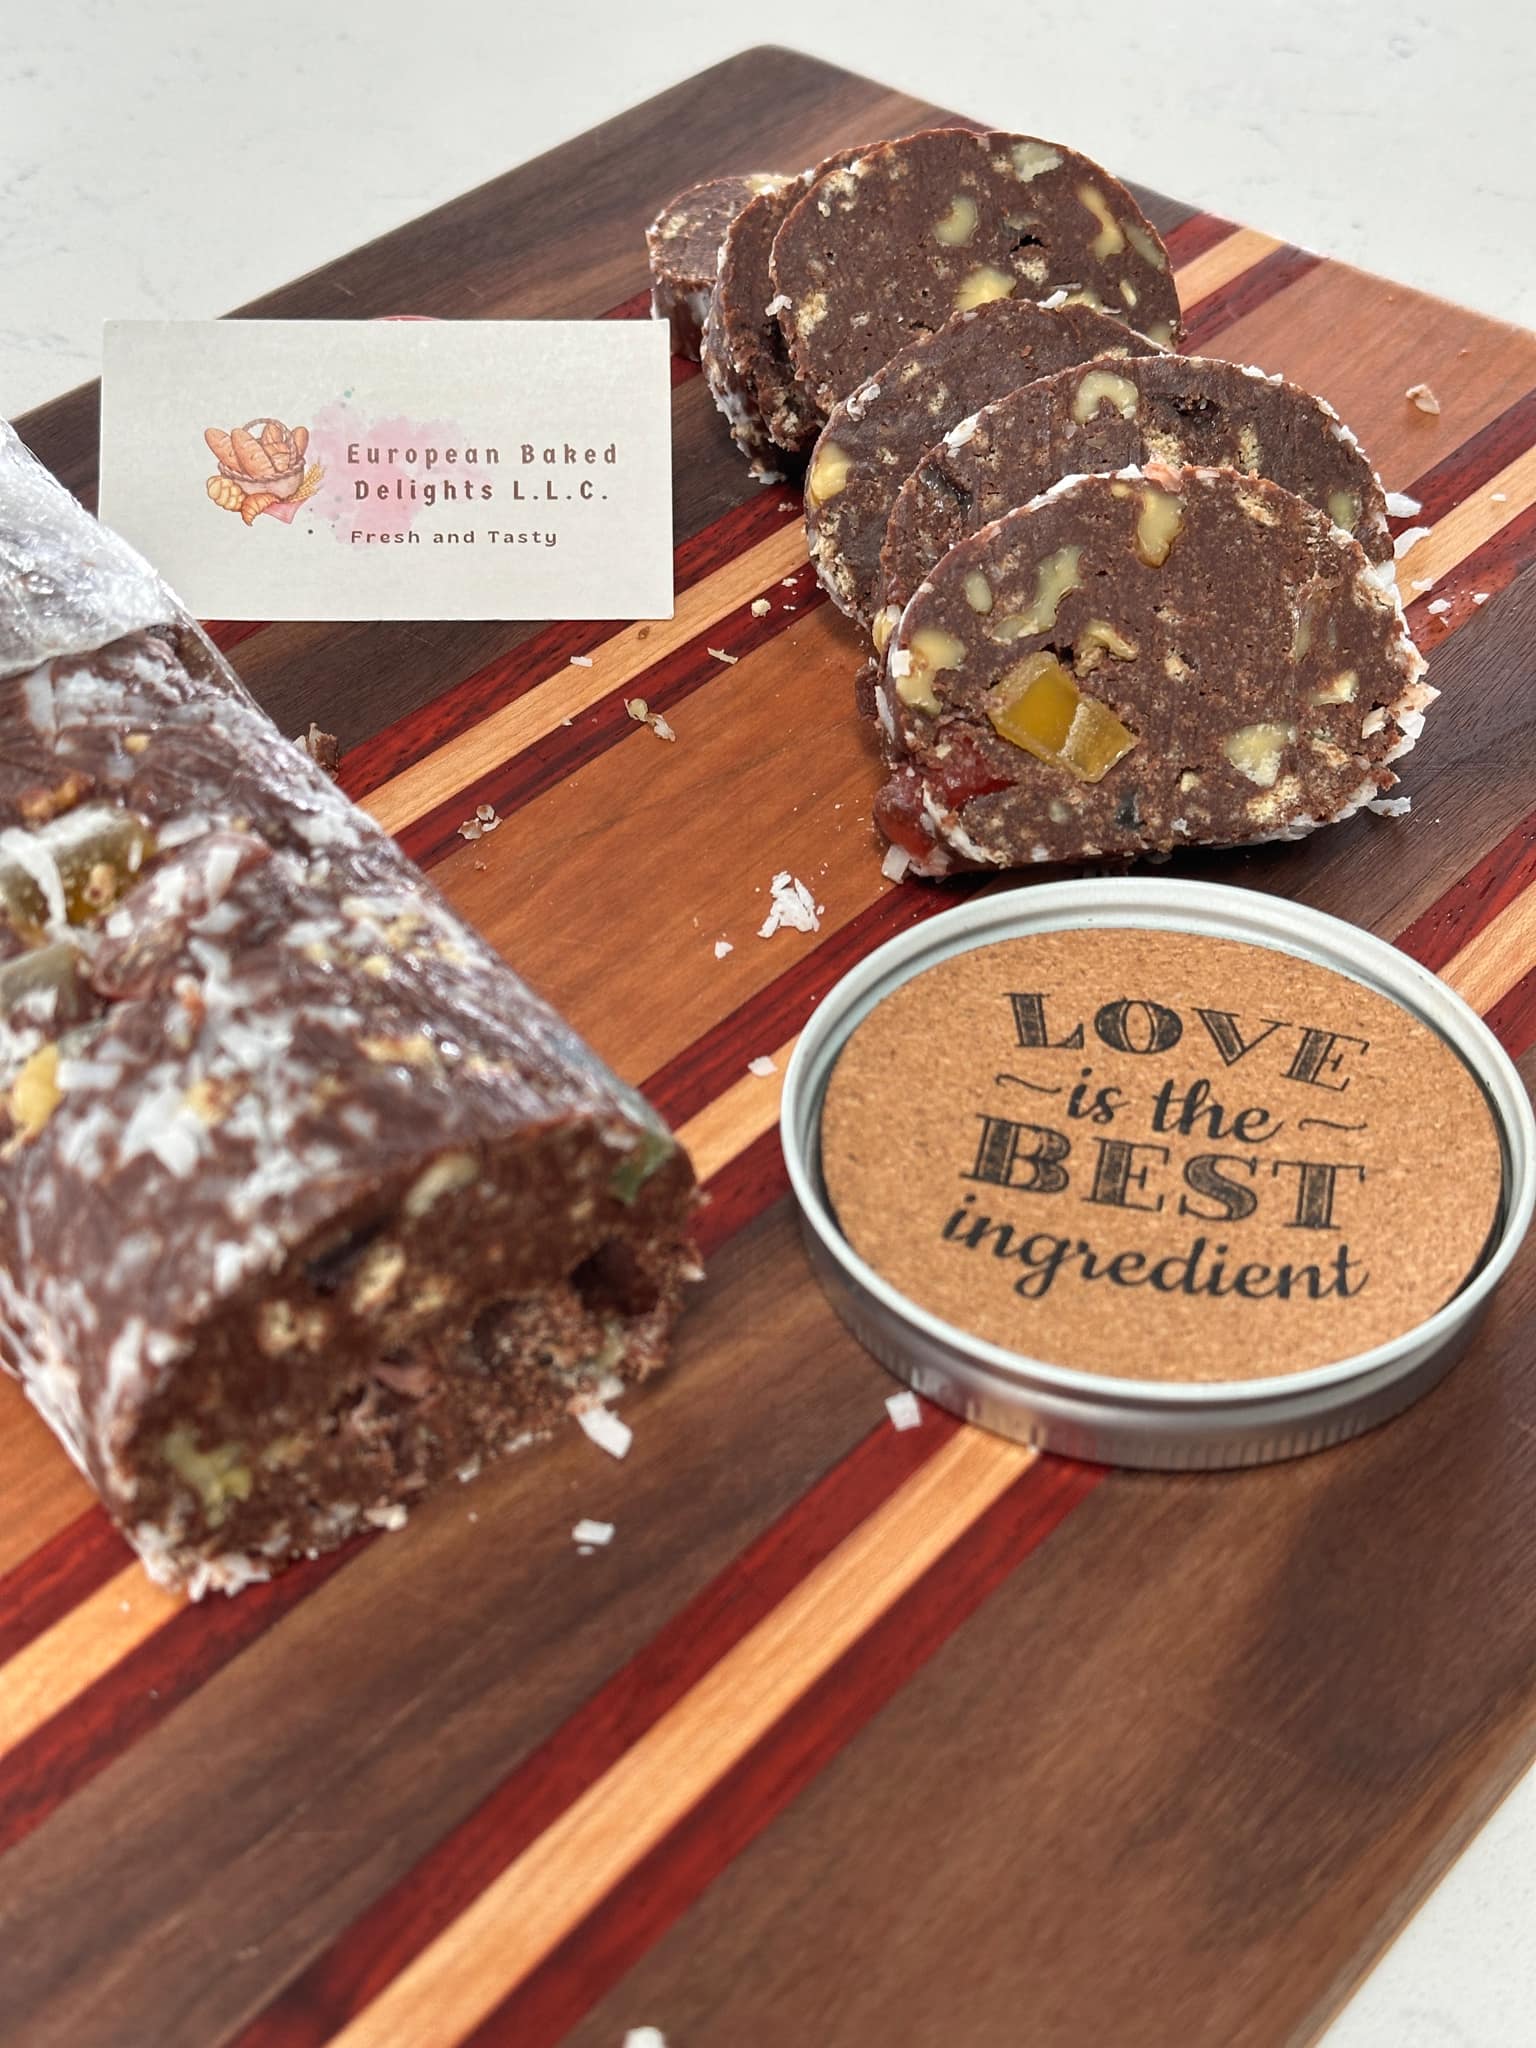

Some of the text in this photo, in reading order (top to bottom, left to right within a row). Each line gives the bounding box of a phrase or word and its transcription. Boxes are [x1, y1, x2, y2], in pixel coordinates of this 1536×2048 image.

[347, 443, 618, 470] European Baked
[354, 479, 610, 507] Delights L.L.C.
[351, 530, 559, 548] Fresh and Tasty
[1002, 991, 1370, 1092] LOVE
[1066, 1066, 1285, 1143] is the
[959, 1113, 1366, 1230] BEST
[941, 1193, 1370, 1299] ingredient
